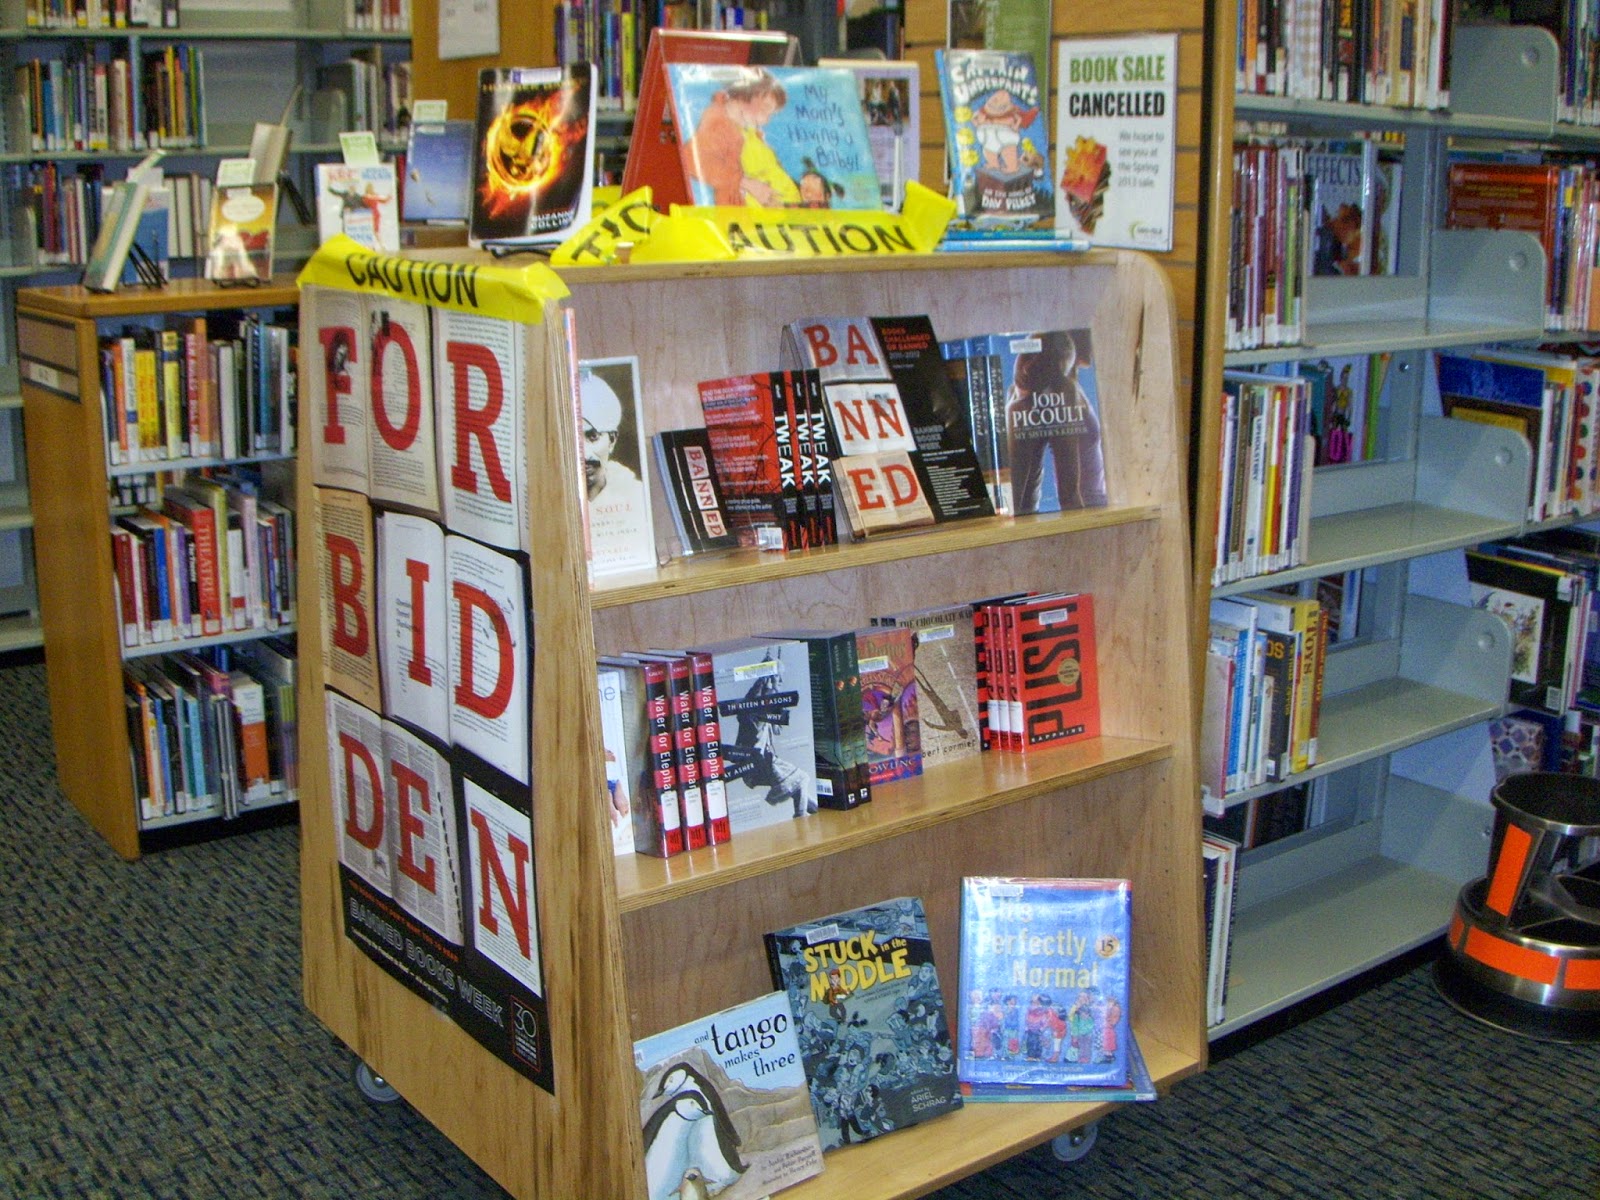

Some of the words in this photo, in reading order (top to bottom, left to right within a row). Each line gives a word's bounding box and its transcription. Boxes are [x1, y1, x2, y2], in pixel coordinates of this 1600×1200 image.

[1070, 57, 1118, 83] BOOK
[1123, 55, 1165, 83] SALE
[804, 84, 828, 105] My
[953, 77, 1039, 106] UNDERPANTS
[1069, 91, 1165, 118] CANCELLED
[787, 123, 840, 147] Having
[1133, 161, 1159, 175] Spring
[728, 222, 917, 254] AUTION
[346, 253, 480, 308] CAUTION
[1032, 392, 1066, 410] JODI
[1012, 405, 1087, 428] PICOULT
[774, 411, 796, 489] TWEAK
[796, 409, 815, 486] TWEAK
[810, 408, 832, 485] TWEAK
[1252, 418, 1263, 481] UPHOLSTERY
[915, 611, 956, 626] CHOCOLATE
[654, 694, 666, 728] Water
[679, 690, 690, 723] Water
[702, 685, 713, 718] Water
[658, 731, 669, 748] for
[683, 726, 692, 743] for
[705, 721, 715, 738] for
[1031, 726, 1083, 743] SAPPHIRE
[707, 741, 719, 782] Elepha
[922, 747, 940, 758] bert
[660, 751, 672, 794] Elepha
[734, 763, 755, 774] ASHER
[868, 759, 914, 774] OWLING
[803, 929, 879, 973] STUCK
[881, 943, 890, 952] in
[891, 938, 907, 949] the
[1101, 940, 1114, 951] 15
[350, 897, 403, 950] BANNED
[405, 938, 455, 990] BOOKS
[457, 976, 504, 1028] WEEK
[810, 948, 912, 1002] MDDLE
[1012, 959, 1099, 989] Normal
[514, 1002, 537, 1038] 30
[694, 1031, 710, 1045] and
[711, 1013, 788, 1056] tango
[724, 1049, 760, 1069] makes
[753, 1052, 796, 1078] three
[911, 1092, 935, 1104] ARIEL
[912, 1096, 947, 1112] SCHRAG
